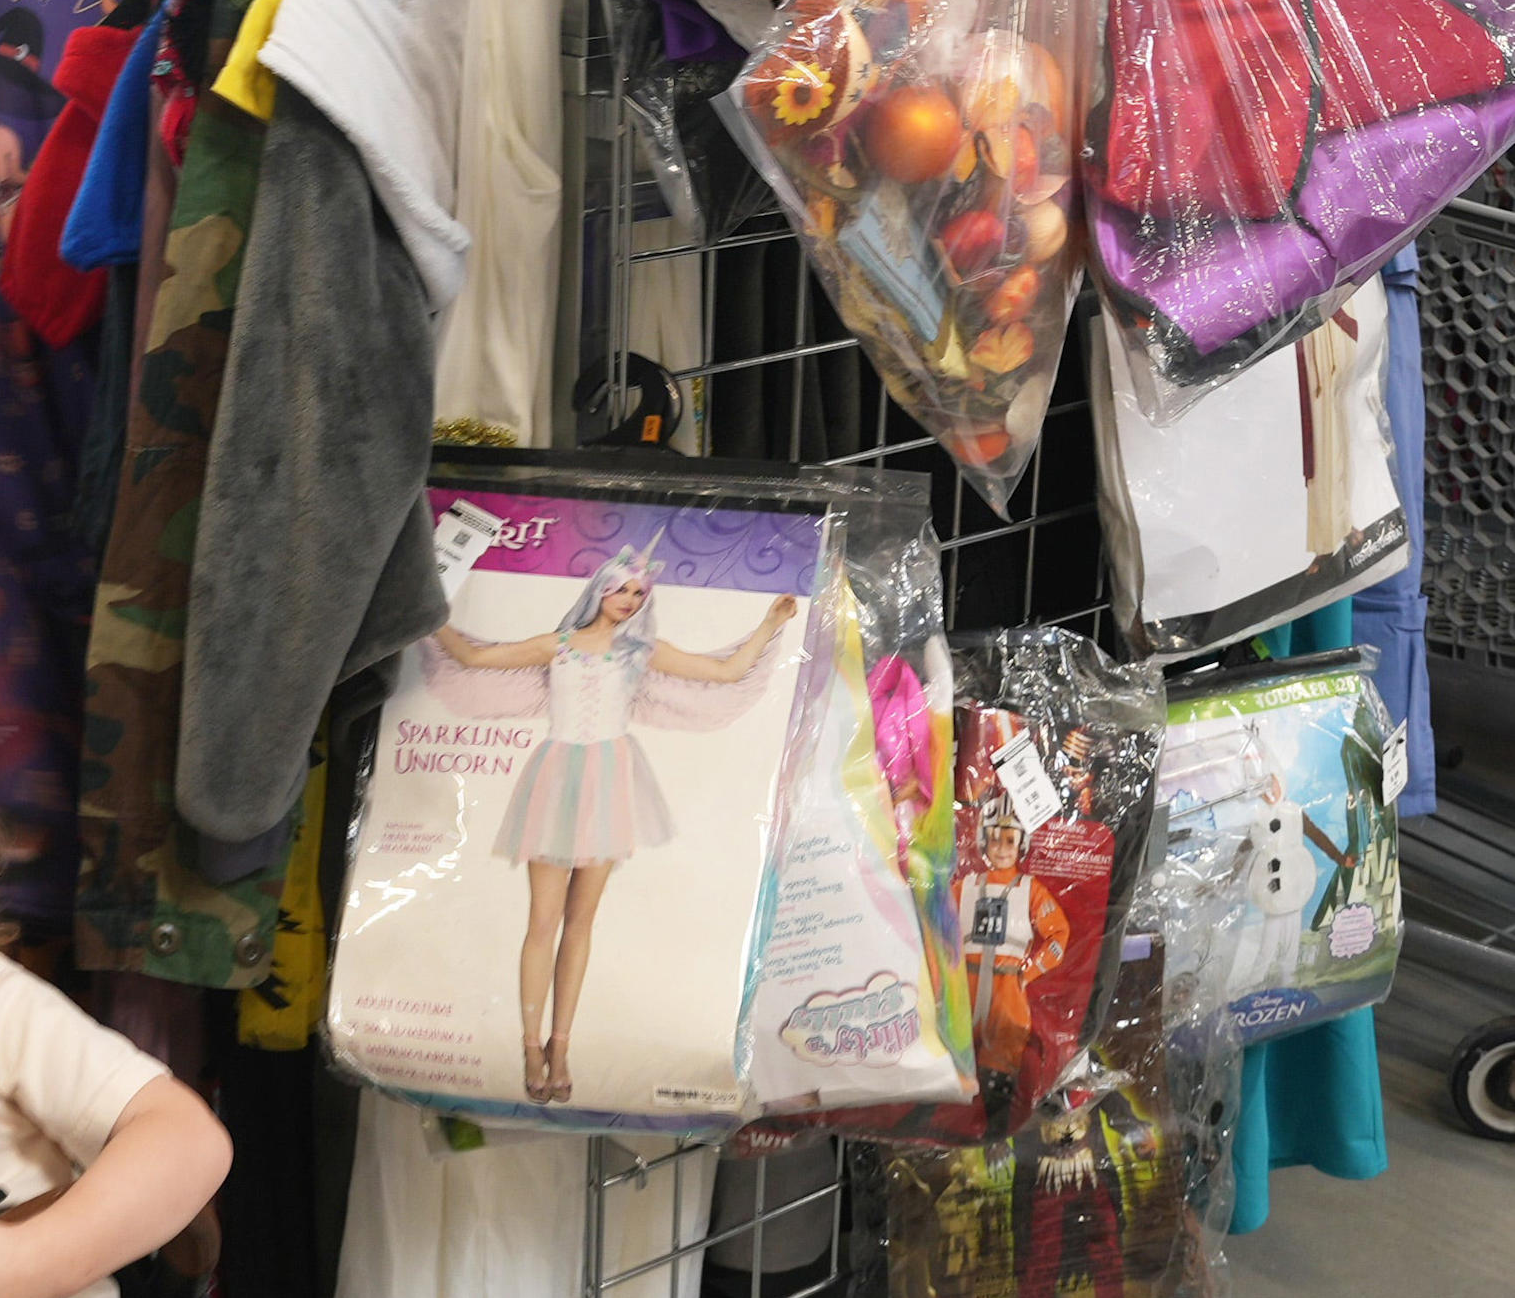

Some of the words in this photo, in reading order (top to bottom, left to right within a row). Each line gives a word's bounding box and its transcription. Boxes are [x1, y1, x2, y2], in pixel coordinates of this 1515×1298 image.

[489, 517, 561, 550] RIT
[395, 718, 534, 749] SPARKLING
[394, 748, 514, 775] UNICORN
[1232, 1001, 1306, 1029] ROZEN
